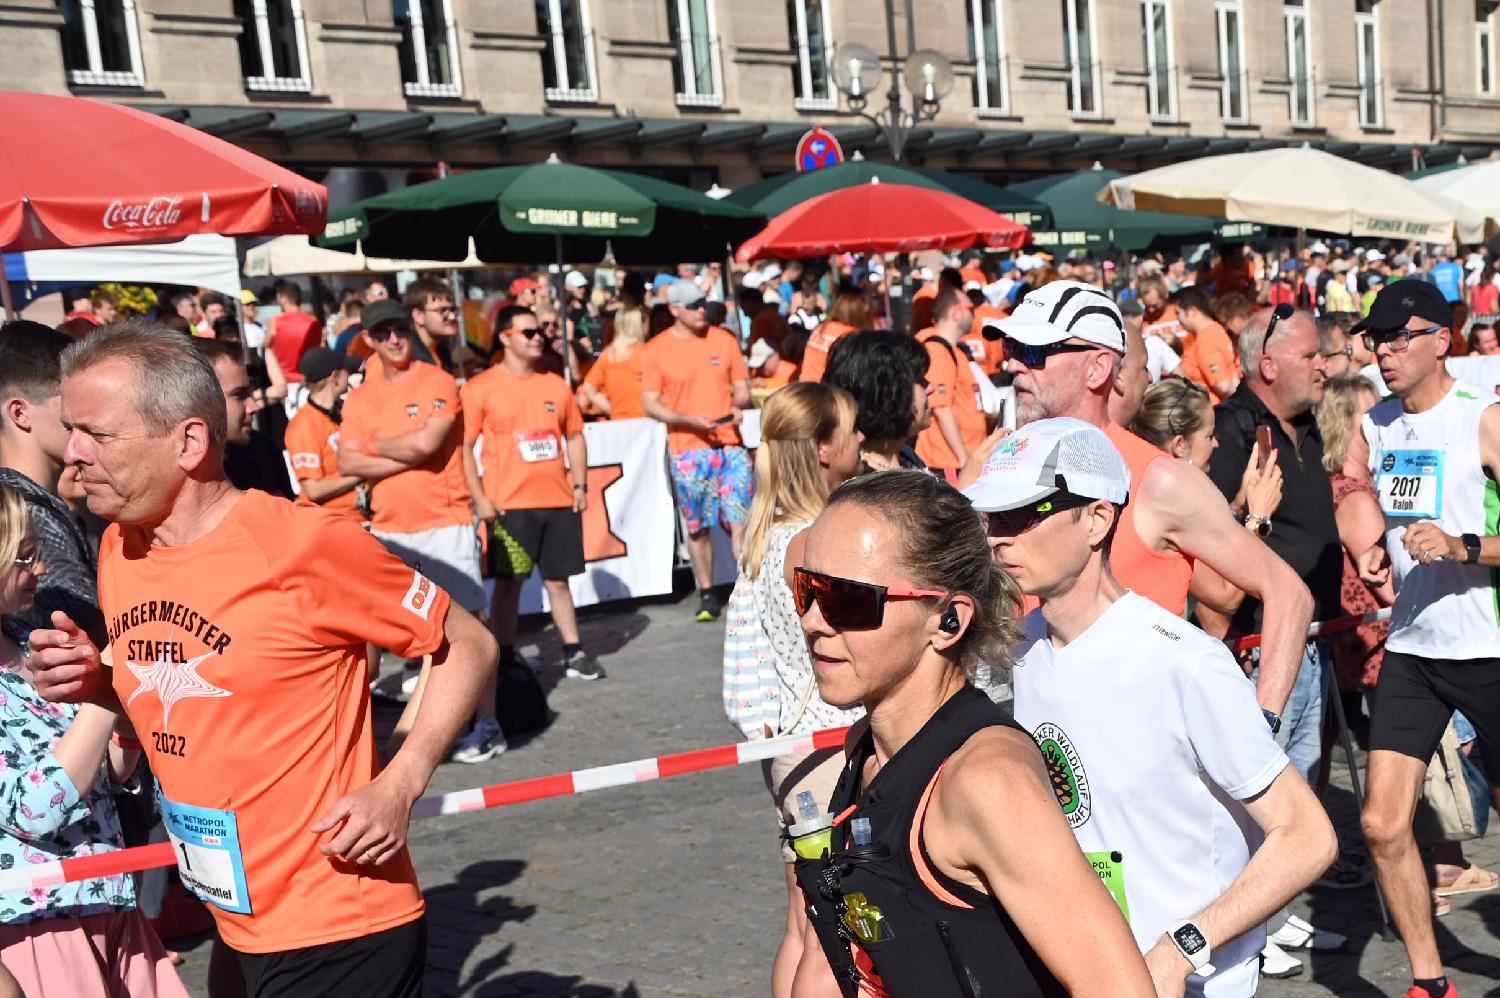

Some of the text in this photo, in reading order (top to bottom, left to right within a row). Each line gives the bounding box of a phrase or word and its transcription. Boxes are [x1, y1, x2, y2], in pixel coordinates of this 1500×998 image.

[102, 196, 183, 230] Coca-Cola
[1390, 477, 1421, 497] 2017
[1392, 499, 1413, 511] Ralph
[109, 600, 232, 655] BÜRGERMEISTER
[127, 640, 188, 663] STAFFEL
[152, 731, 186, 757] 2022
[1057, 732, 1089, 800] WALDLAUF
[182, 814, 226, 827] METROPOL
[184, 823, 227, 836] MARATHON
